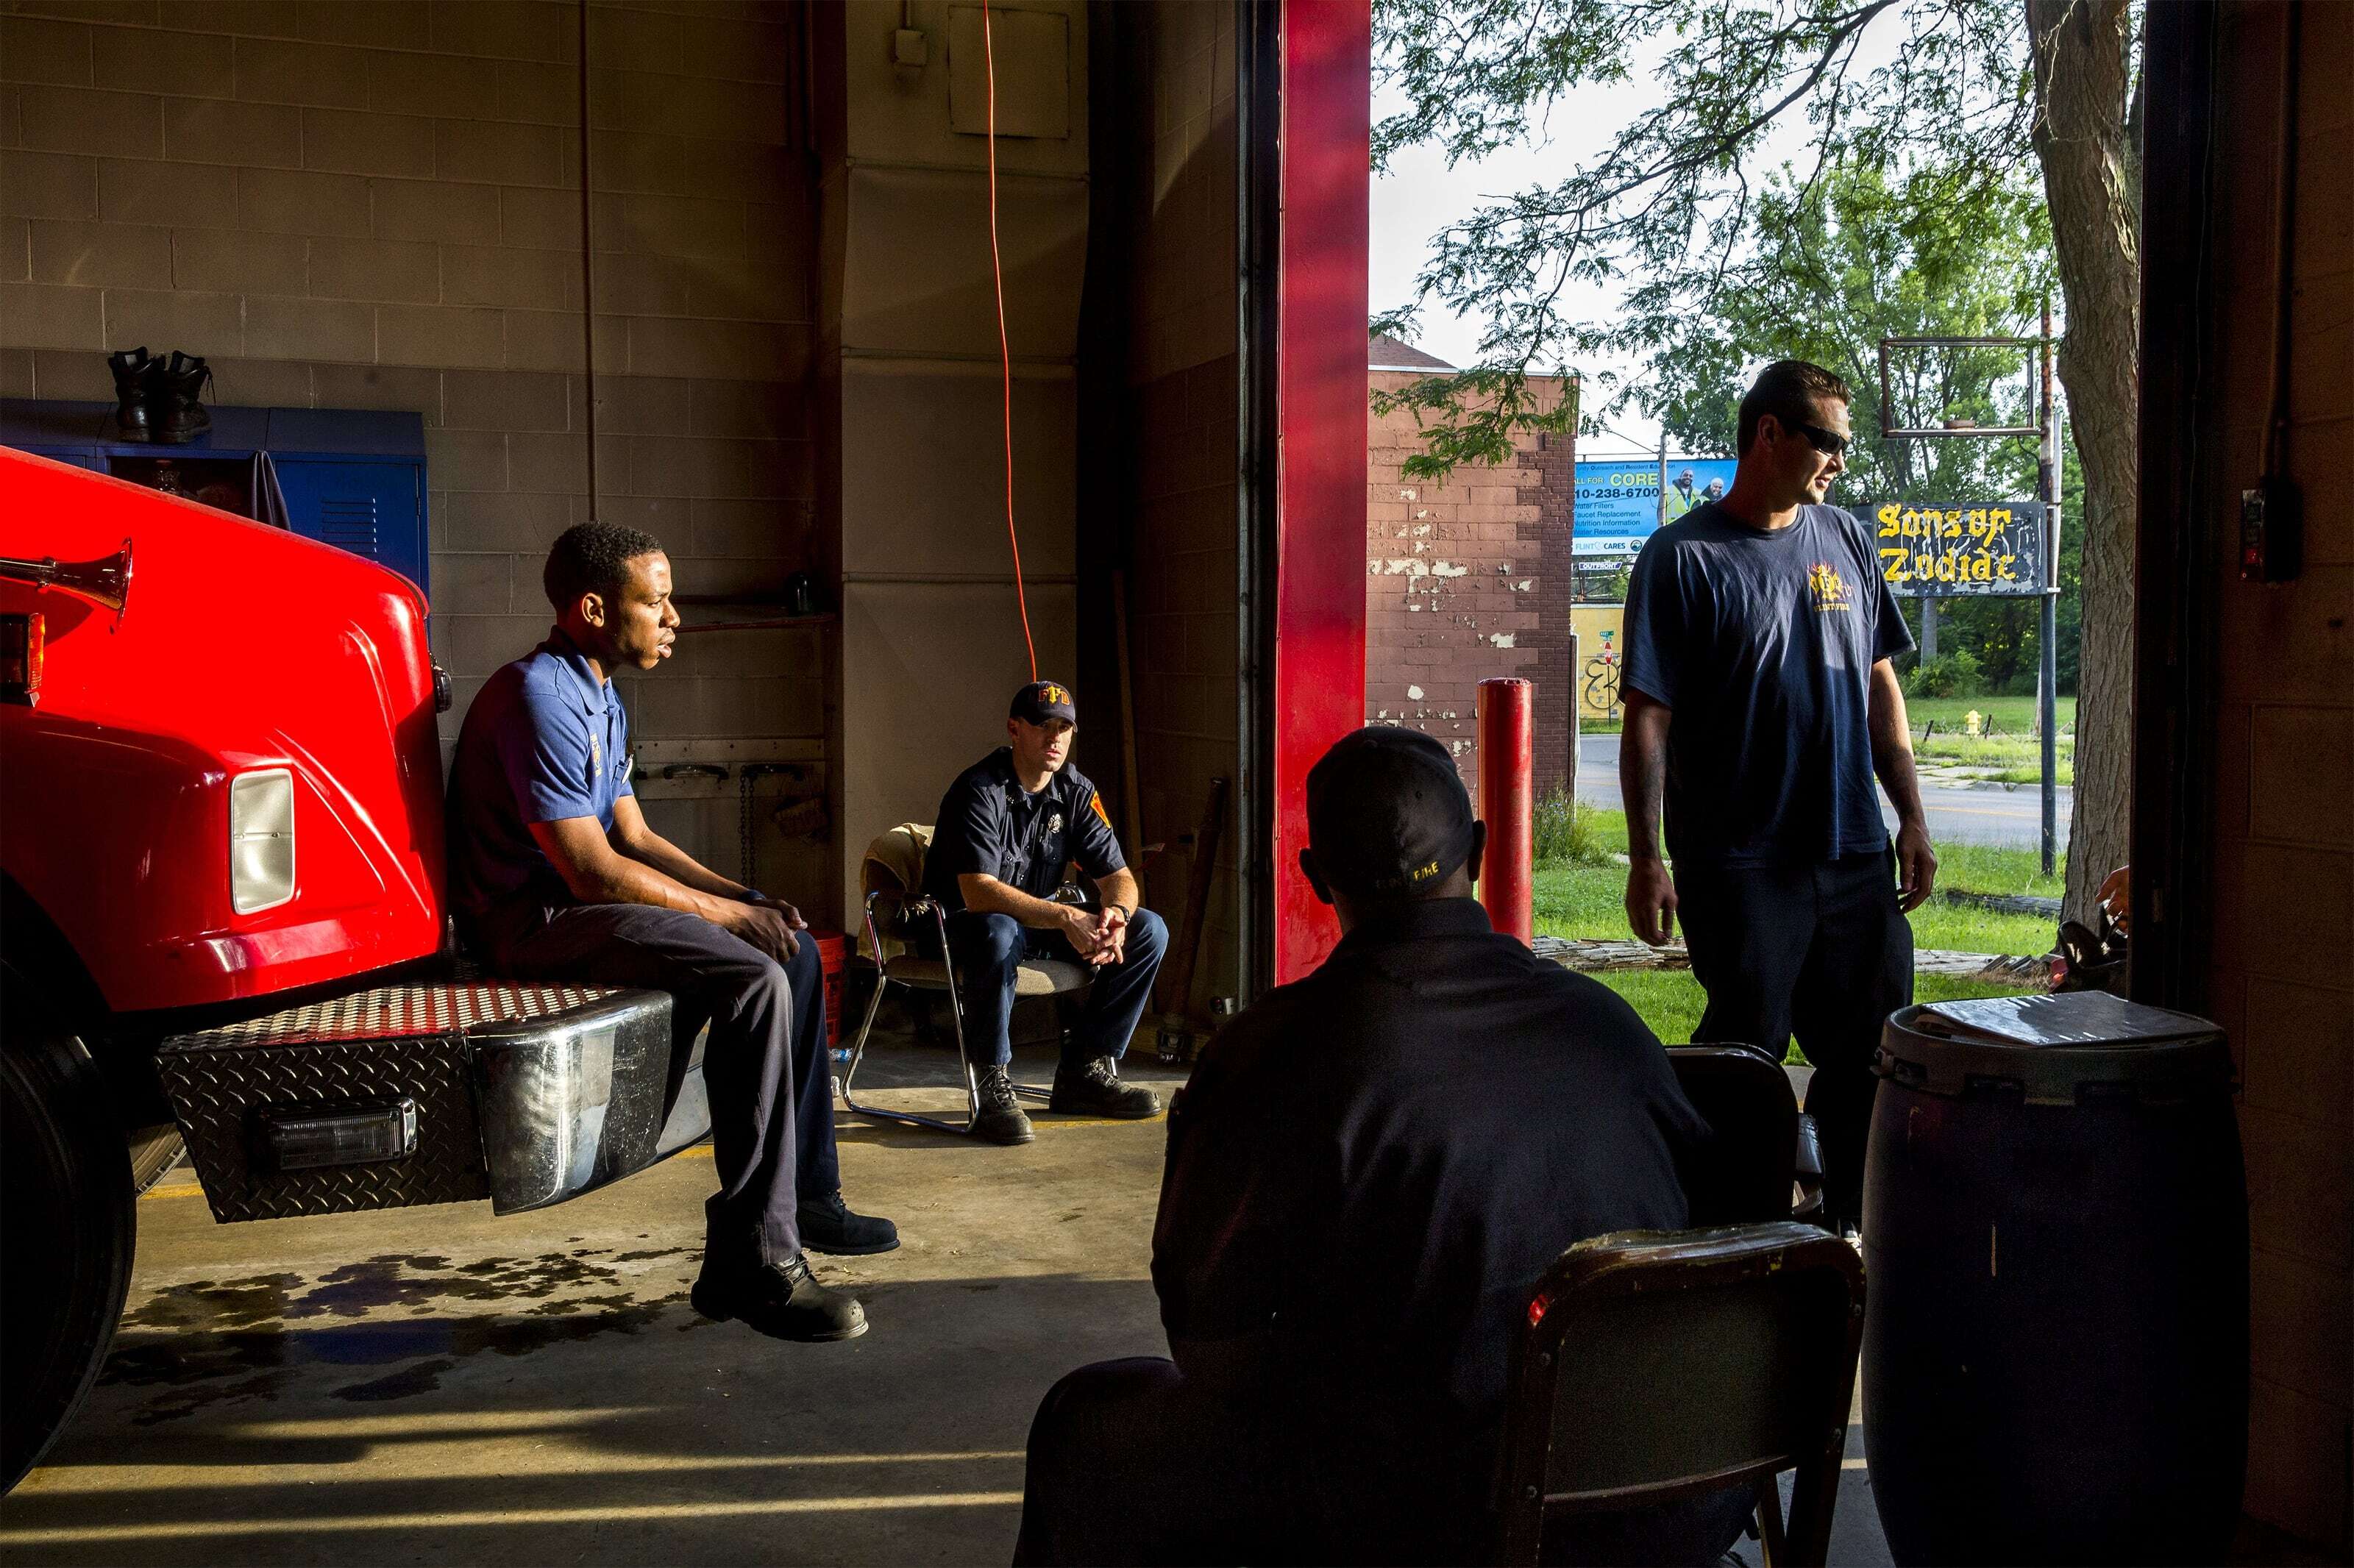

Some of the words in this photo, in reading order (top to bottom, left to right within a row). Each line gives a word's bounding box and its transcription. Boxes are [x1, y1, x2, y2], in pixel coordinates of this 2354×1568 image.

[1610, 472, 1660, 487] CORE
[1574, 488, 1660, 499] 10-238-6700
[1597, 510, 1641, 519] Replacement
[1877, 503, 1963, 538] Sons
[1602, 518, 1640, 527] Information
[1575, 542, 1594, 550] FLINT
[1880, 547, 2016, 582] Zodiac
[1414, 860, 1439, 881] FIRE
